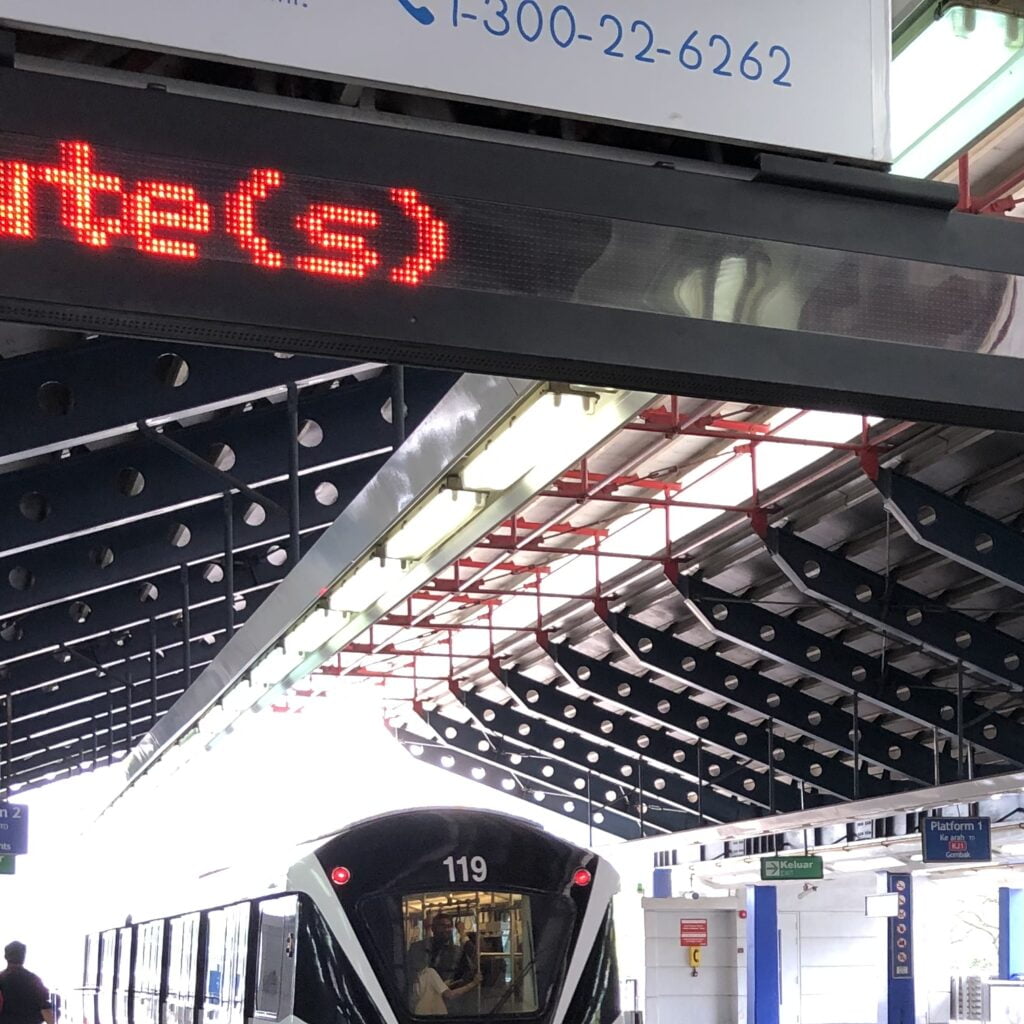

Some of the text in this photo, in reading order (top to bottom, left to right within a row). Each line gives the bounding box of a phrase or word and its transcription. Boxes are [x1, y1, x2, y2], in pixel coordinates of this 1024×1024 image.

[452, 0, 793, 88] 1-300-22-6262
[12, 807, 21, 818] 2
[930, 820, 983, 831] Platform 1
[442, 855, 488, 882] 119
[780, 860, 814, 869] Keluar
